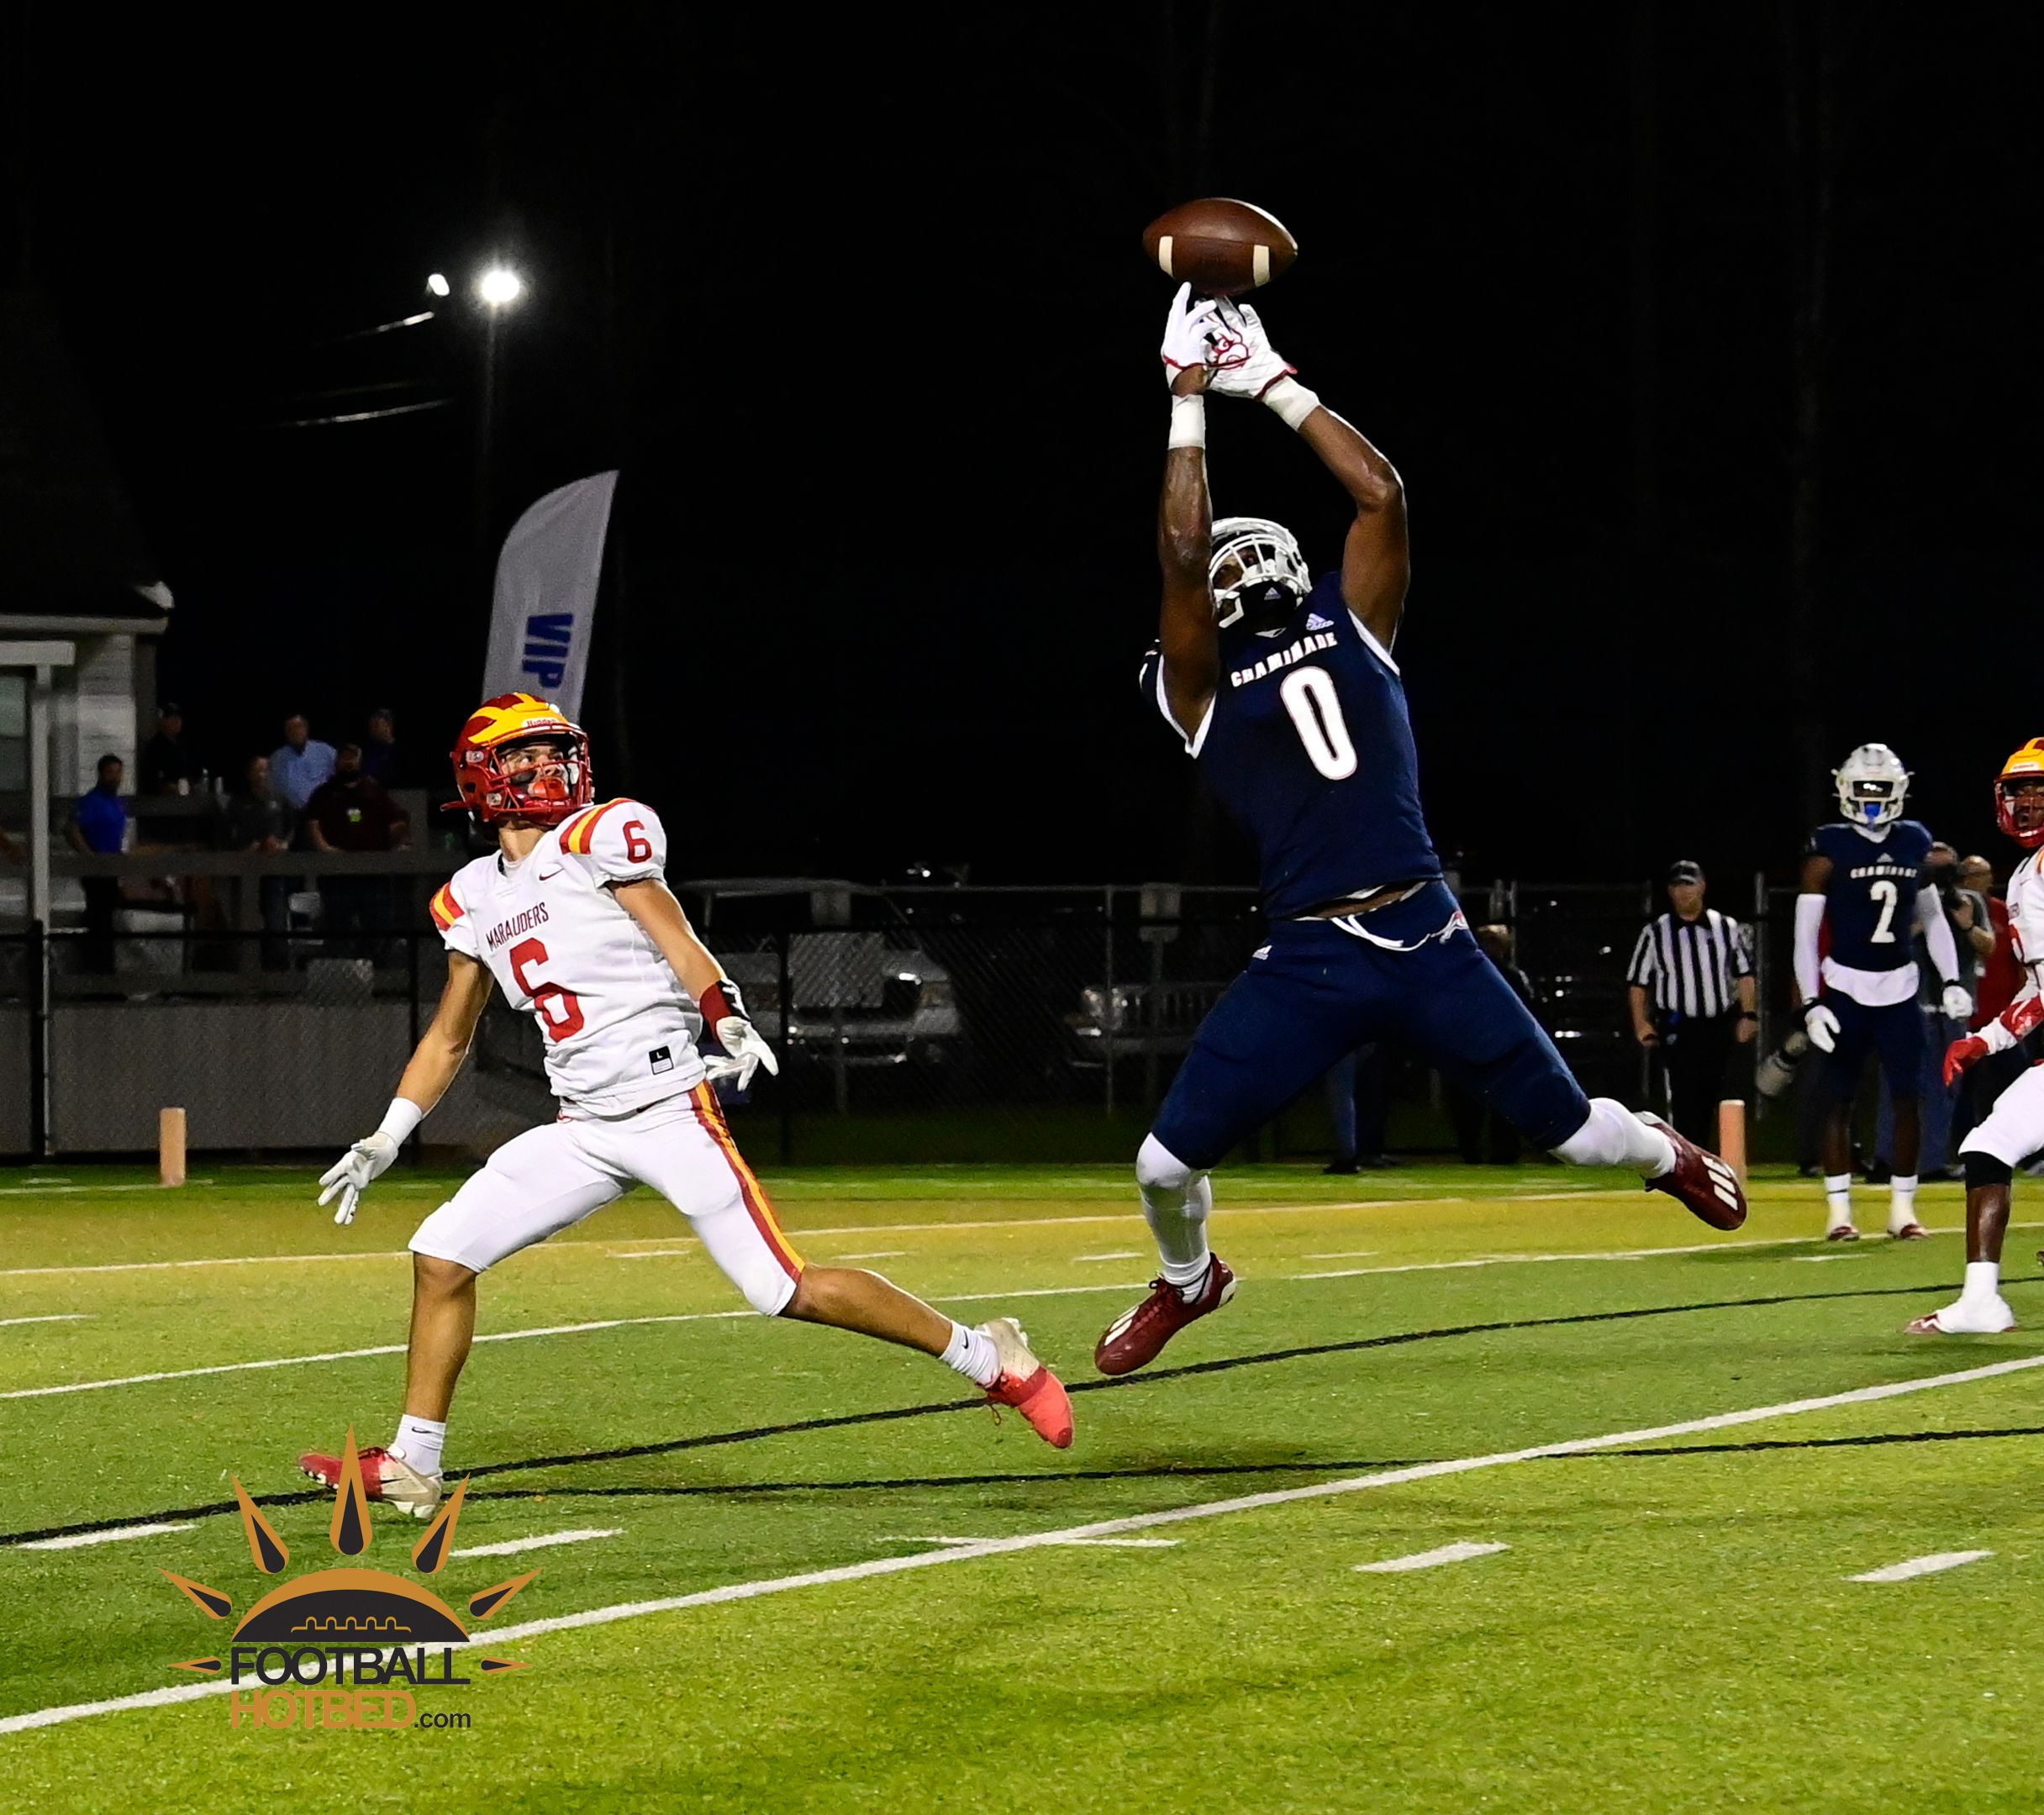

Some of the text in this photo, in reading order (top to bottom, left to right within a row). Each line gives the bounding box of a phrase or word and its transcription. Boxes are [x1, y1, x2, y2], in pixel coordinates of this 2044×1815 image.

[521, 613, 573, 689] VIP
[1230, 632, 1338, 687] CHAMINADE
[1280, 666, 1357, 780] 0
[623, 820, 652, 864] 6
[485, 902, 549, 951] MARAUDERS
[1870, 880, 1897, 943] 2
[509, 937, 584, 1043] 6
